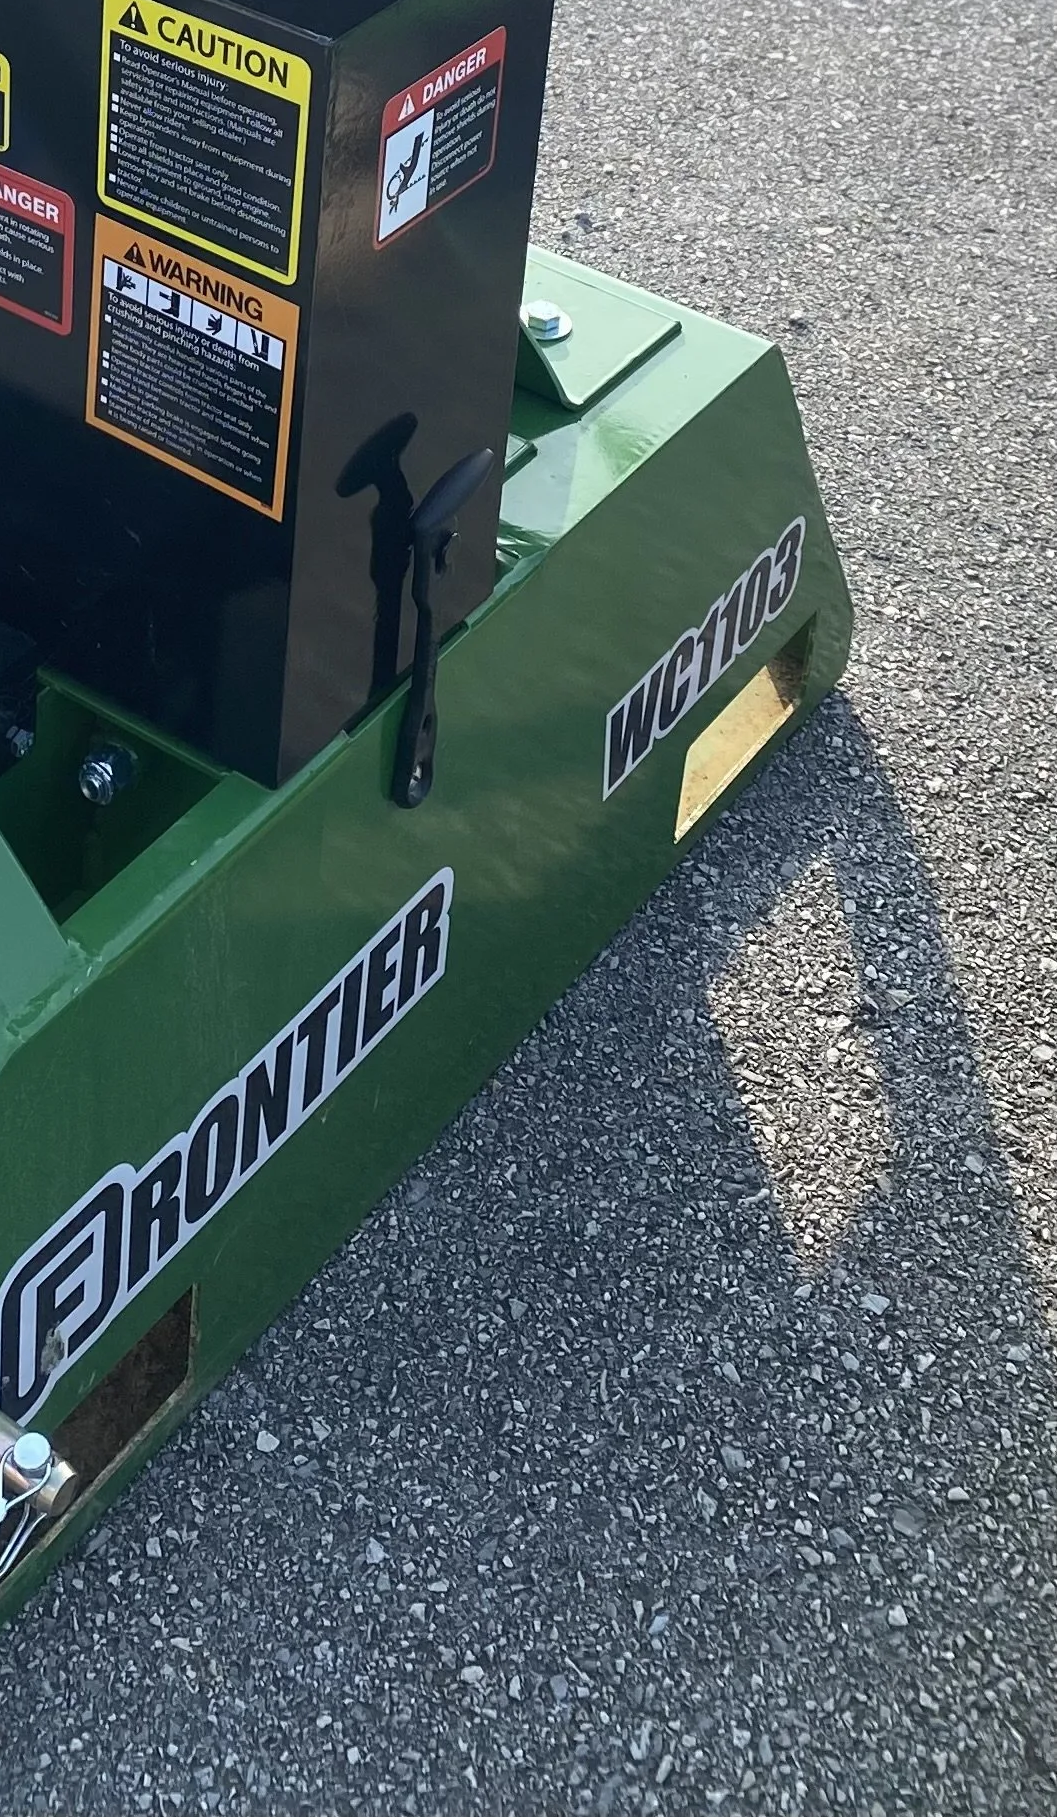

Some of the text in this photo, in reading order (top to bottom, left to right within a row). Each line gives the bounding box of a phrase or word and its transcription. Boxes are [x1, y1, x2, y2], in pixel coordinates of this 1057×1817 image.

[118, 38, 131, 53] To
[132, 43, 159, 63] avoid
[160, 55, 196, 78] serious
[121, 54, 140, 70] Read
[180, 78, 210, 98] Manual
[210, 90, 236, 108] before
[157, 16, 289, 88] CAUTION
[422, 47, 487, 105] DANGER
[120, 66, 154, 88] servicing
[155, 80, 163, 90] or
[164, 83, 199, 106] repairing
[245, 115, 272, 134] Follow
[272, 126, 283, 138] all
[120, 95, 141, 112] Never
[142, 104, 163, 121] allow
[120, 85, 153, 106] available
[153, 99, 172, 114] from
[172, 108, 190, 123] your
[191, 114, 217, 134] selling
[120, 74, 142, 93] safety
[143, 84, 162, 100] rules
[162, 91, 178, 106] and
[226, 117, 262, 142] (Manuals
[262, 134, 276, 146] are
[118, 126, 148, 148] Operate
[149, 138, 167, 154] from
[168, 147, 194, 165] tractor
[194, 158, 211, 172] seat
[118, 136, 137, 153] Keep
[137, 144, 147, 156] all
[147, 148, 173, 167] shields
[174, 160, 182, 171] in
[183, 163, 204, 182] place
[204, 172, 220, 187] and
[220, 179, 242, 198] good
[119, 106, 291, 187] Keep bystanders away from equipment during
[116, 186, 145, 207] operate
[117, 157, 286, 238] remove key and set brake before dismounting
[118, 146, 140, 163] Lower
[141, 156, 182, 183] equipment
[182, 174, 191, 185] to
[223, 191, 241, 208] stop
[4, 225, 26, 241] cause
[27, 235, 55, 254] serious
[10, 217, 17, 228] in
[18, 220, 49, 244] rotating
[116, 176, 279, 254] Never allow children or untrained persons to
[6, 267, 25, 283] with
[12, 253, 21, 264] in
[149, 249, 263, 322] WARNING
[106, 300, 143, 328] crushing
[144, 318, 161, 335] and
[162, 327, 199, 356] pinching
[107, 290, 260, 372] To avoid serious injury or death from
[607, 523, 802, 792] WC1103
[0, 882, 446, 1421] FRONTIER
